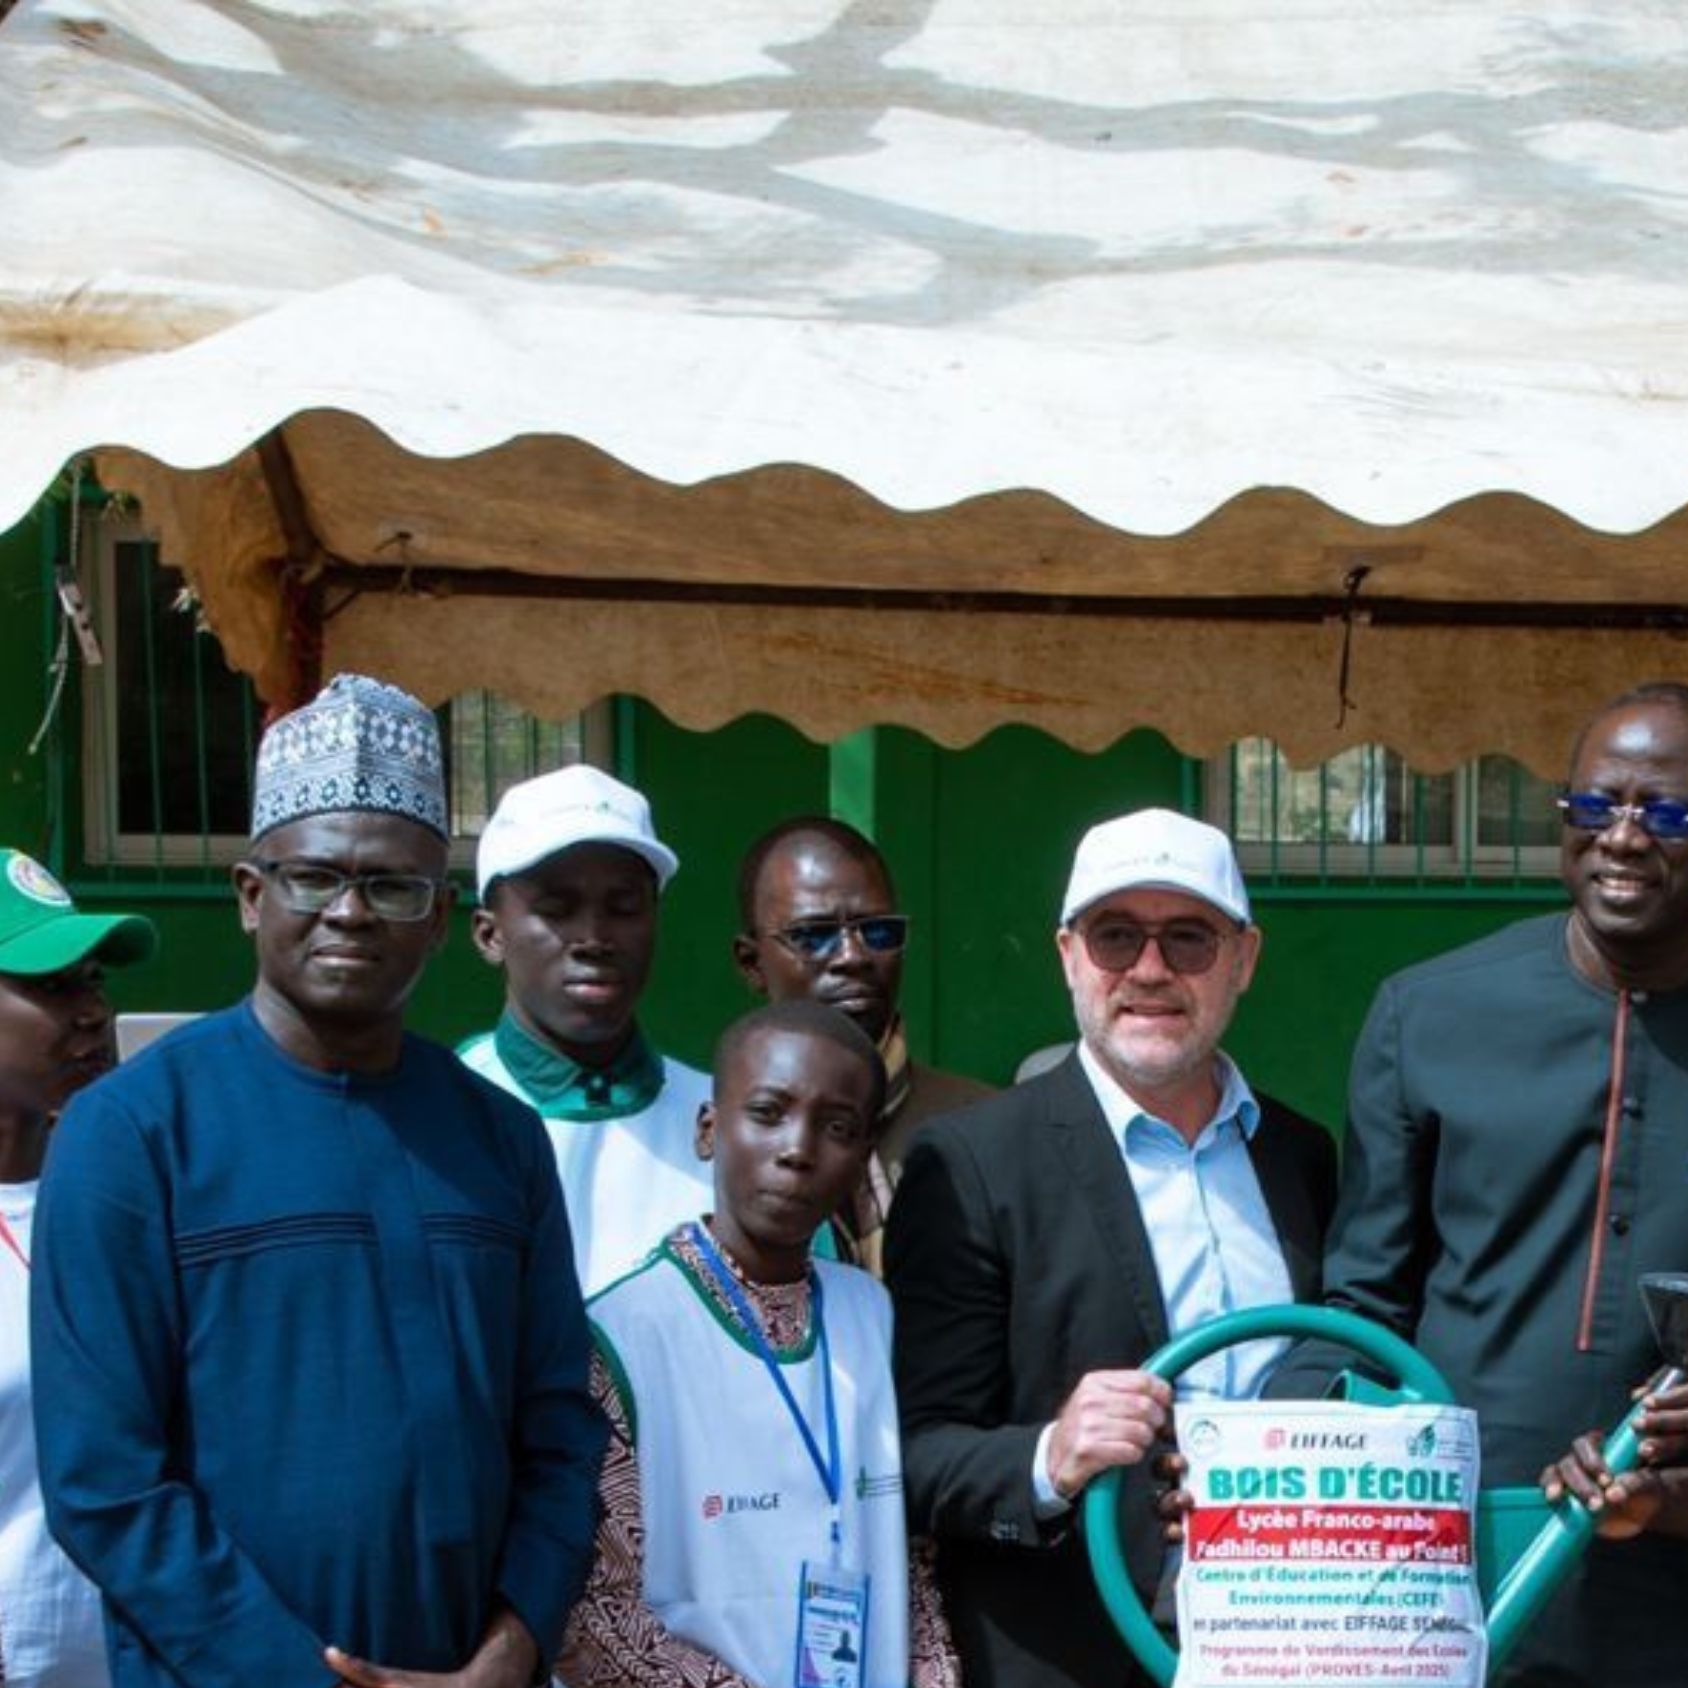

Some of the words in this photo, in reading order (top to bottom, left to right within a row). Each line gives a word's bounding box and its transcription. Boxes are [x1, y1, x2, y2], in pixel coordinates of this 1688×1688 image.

[1208, 1466, 1306, 1499] BOIS
[1319, 1461, 1462, 1501] D'ÉCOLE
[1288, 1538, 1380, 1558] MBACKE
